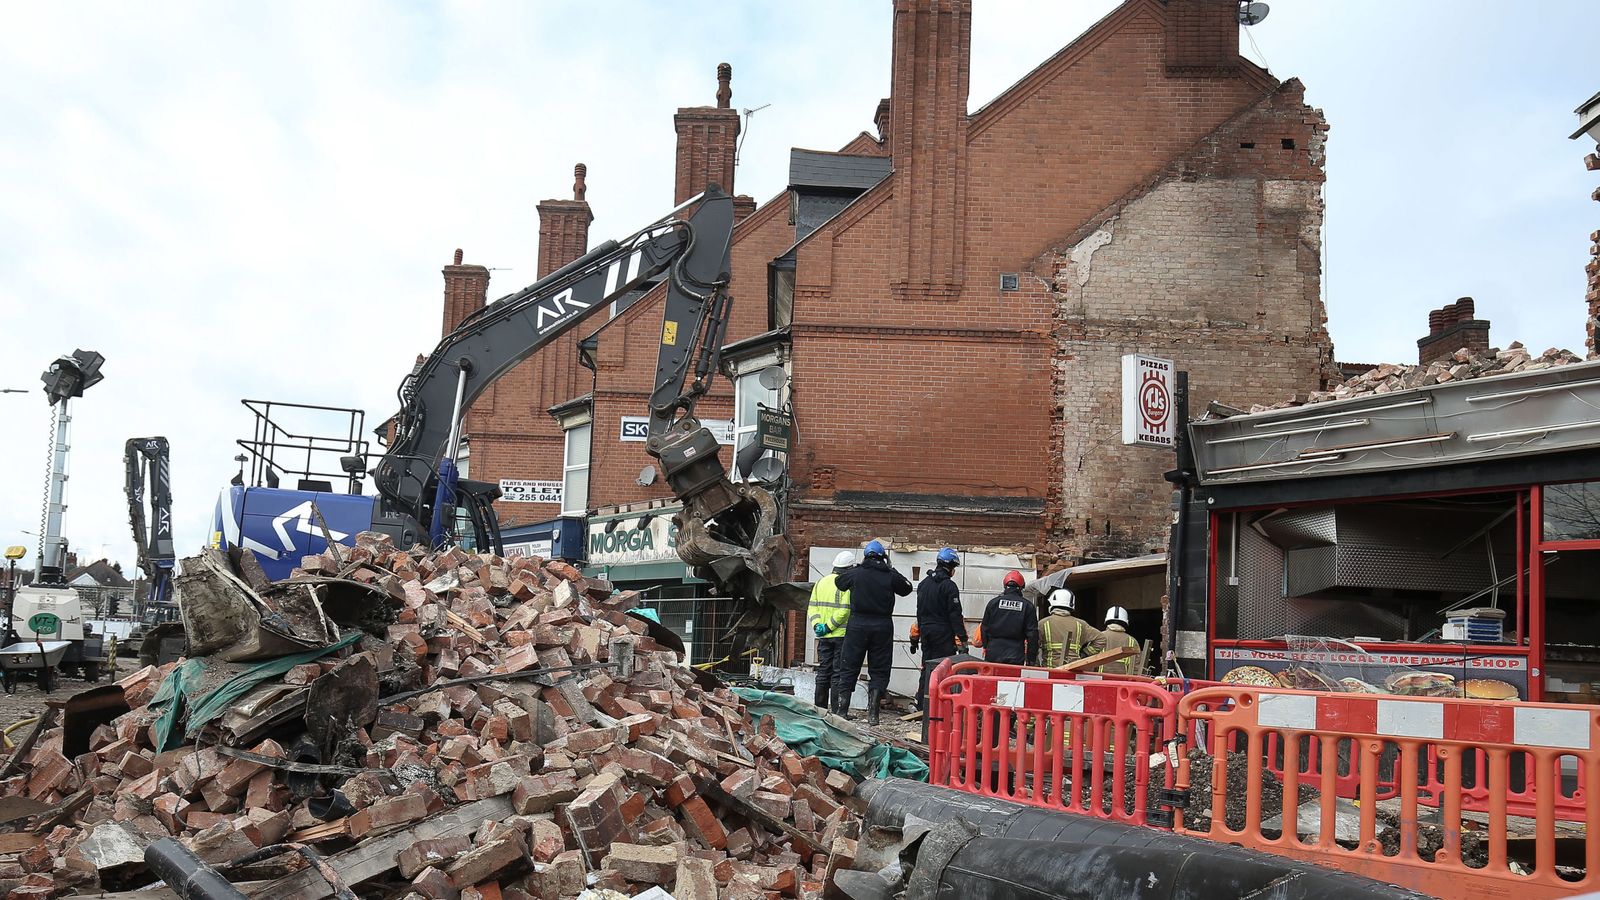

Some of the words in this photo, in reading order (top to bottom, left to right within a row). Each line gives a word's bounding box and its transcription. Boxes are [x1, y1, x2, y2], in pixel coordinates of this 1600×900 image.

[537, 287, 592, 329] AR
[1140, 360, 1169, 371] PIZZAS
[760, 413, 791, 427] MORGANS
[769, 425, 782, 434] BAR
[1138, 434, 1171, 444] KEBABS
[1001, 600, 1020, 608] FIRE
[1250, 651, 1285, 660] YOUR
[1291, 652, 1326, 661] BEST
[1330, 654, 1375, 664] LOCAL
[1380, 655, 1465, 666] TAKEAWAY
[1471, 658, 1520, 668] SHOP
